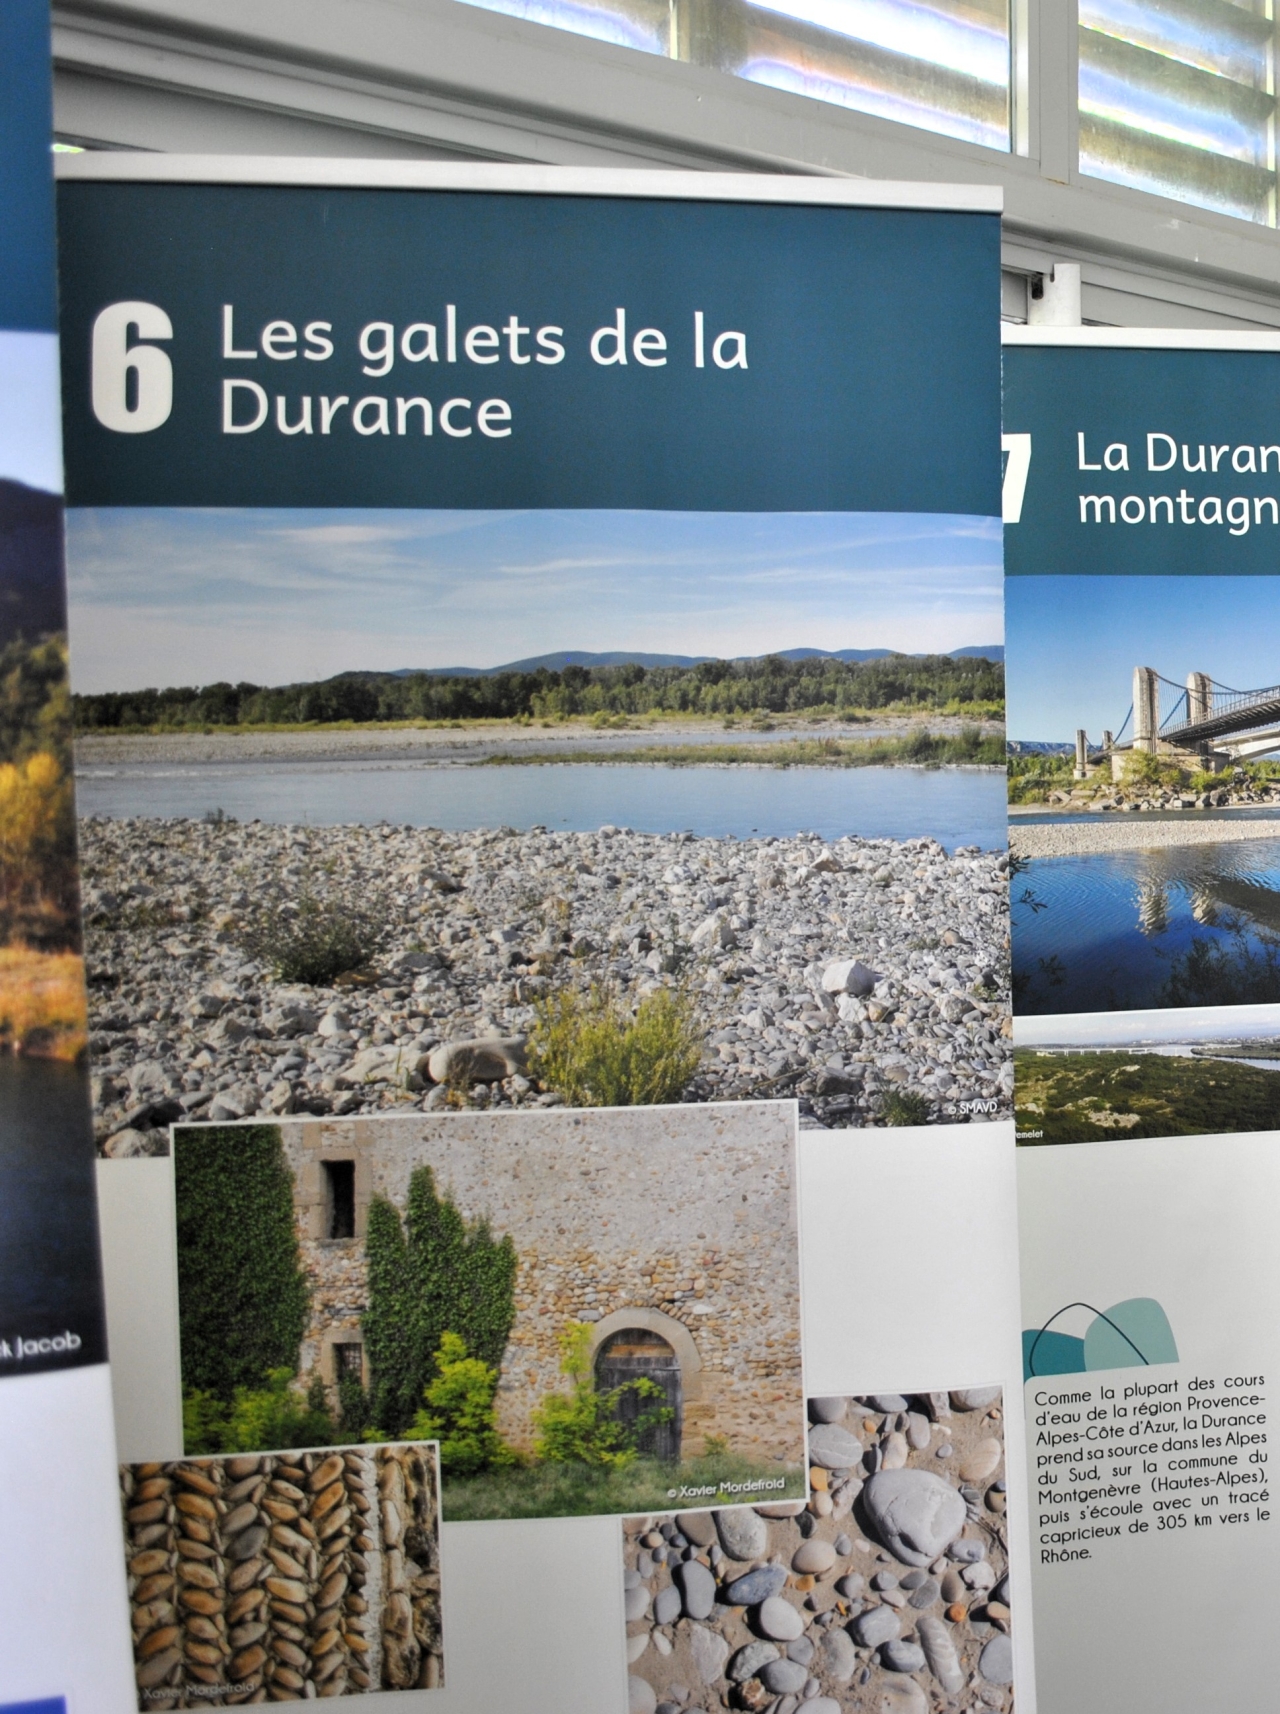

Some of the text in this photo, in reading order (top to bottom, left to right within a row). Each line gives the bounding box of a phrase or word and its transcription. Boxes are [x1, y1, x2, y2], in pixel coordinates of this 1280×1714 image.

[223, 304, 748, 377] Les galets de la
[92, 301, 173, 433] 6
[223, 379, 512, 438] Durance
[1078, 432, 1129, 471] La
[1001, 433, 1032, 524] 7
[959, 1101, 998, 1114] SMAVD
[17, 1330, 82, 1360] Jacob
[1034, 1376, 1265, 1406] Comme la plupart des cours
[1035, 1395, 1265, 1426] d'eau de la région Provence-
[1036, 1414, 1266, 1448] Alpes-Côte d'Azur, la Durance
[1037, 1431, 1267, 1468] prend sa source dans les Alpes
[1038, 1449, 1268, 1485] du Sud, sur la commune du
[679, 1485, 717, 1498] Xavier
[720, 1477, 785, 1493] Mordefroid
[1038, 1468, 1268, 1505] Montgenèvre (Hautes-Alpes),
[1039, 1489, 1269, 1528] puis s'écoule avec un tracé
[1040, 1507, 1270, 1545] capricieux de 305 km vers le
[1041, 1549, 1092, 1564] Rhône.
